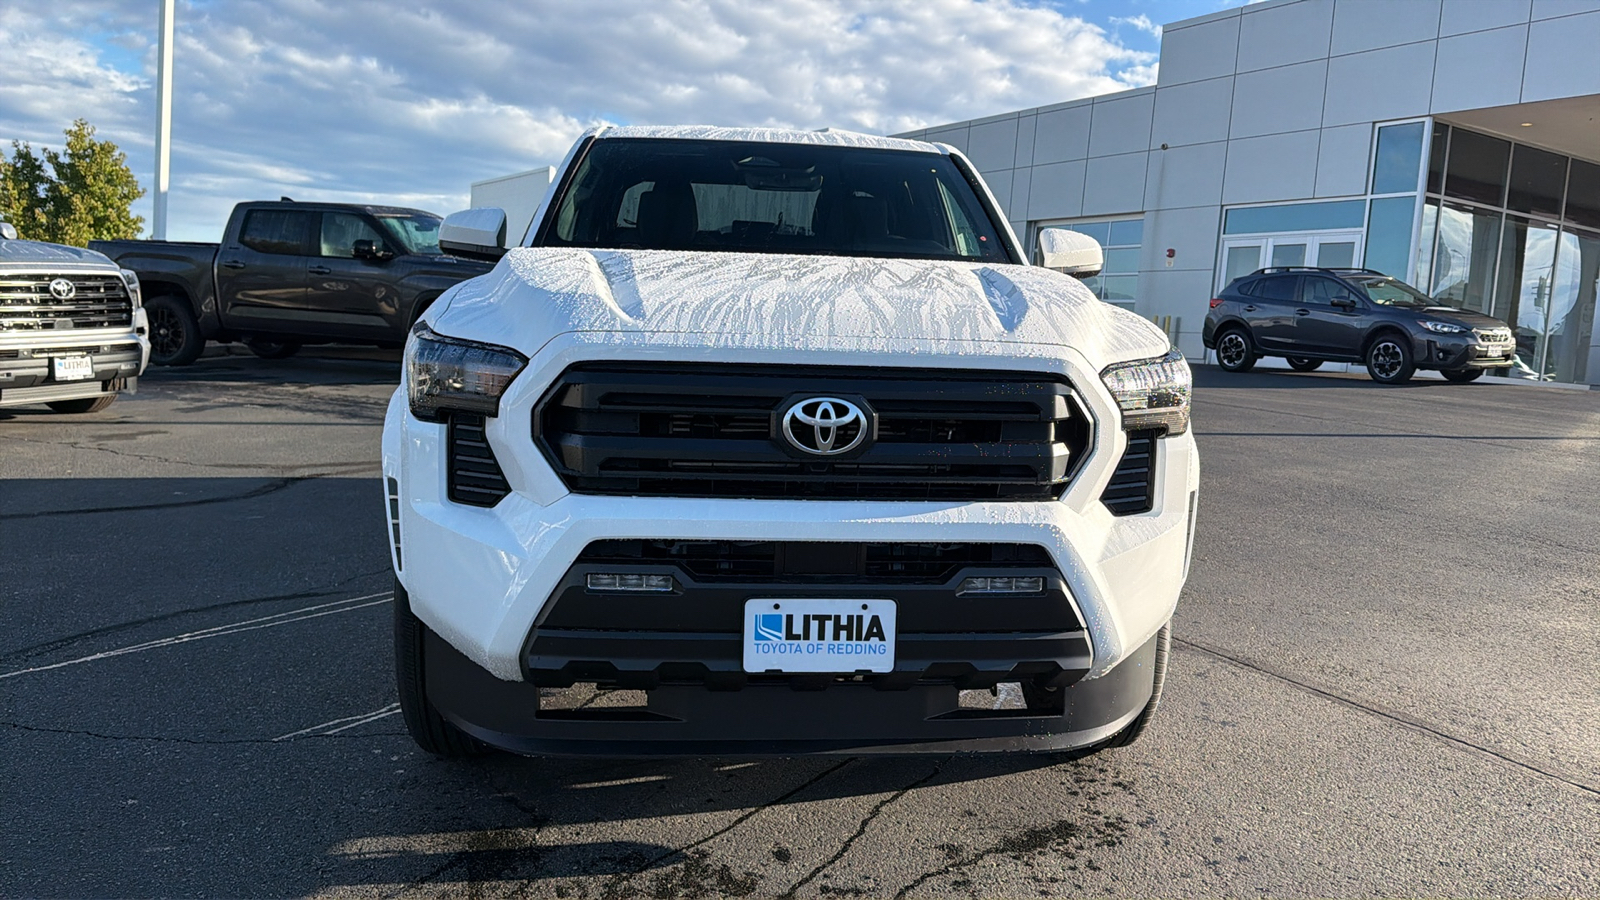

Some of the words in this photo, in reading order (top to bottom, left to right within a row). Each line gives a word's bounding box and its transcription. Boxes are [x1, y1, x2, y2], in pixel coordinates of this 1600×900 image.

[64, 361, 89, 369] LITHIA
[785, 614, 886, 641] LITHIA
[754, 643, 803, 654] TOYOTA
[806, 643, 824, 654] OF
[827, 644, 887, 655] REDDING
